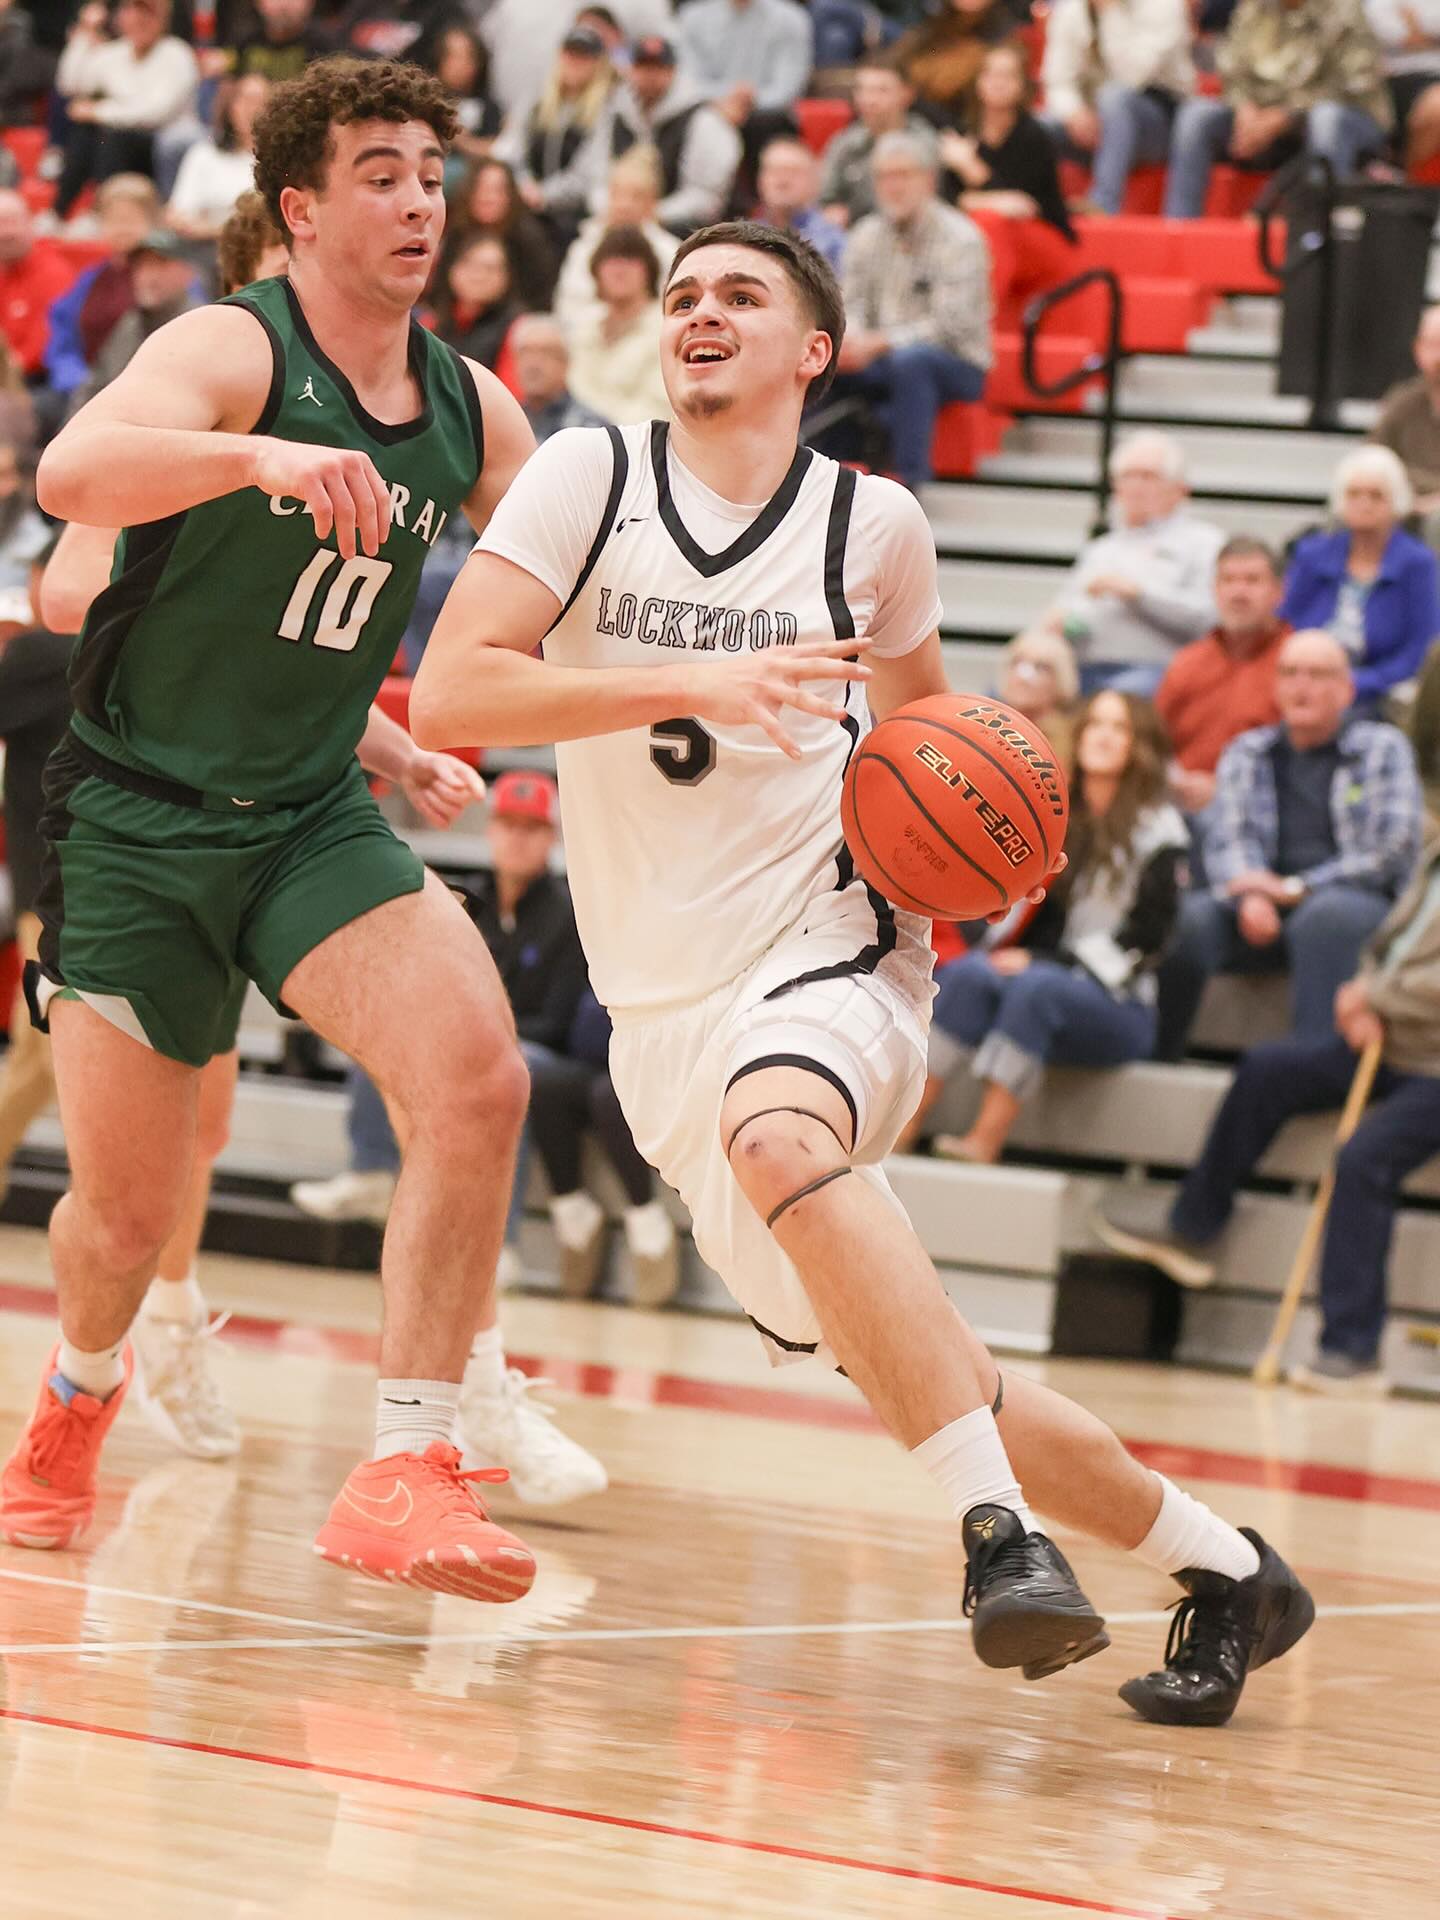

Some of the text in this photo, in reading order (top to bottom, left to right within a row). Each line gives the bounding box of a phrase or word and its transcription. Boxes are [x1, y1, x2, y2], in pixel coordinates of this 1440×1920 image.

[277, 547, 393, 652] 10
[597, 587, 798, 652] LOCKWOOD
[913, 741, 1032, 865] ELITE PRO
